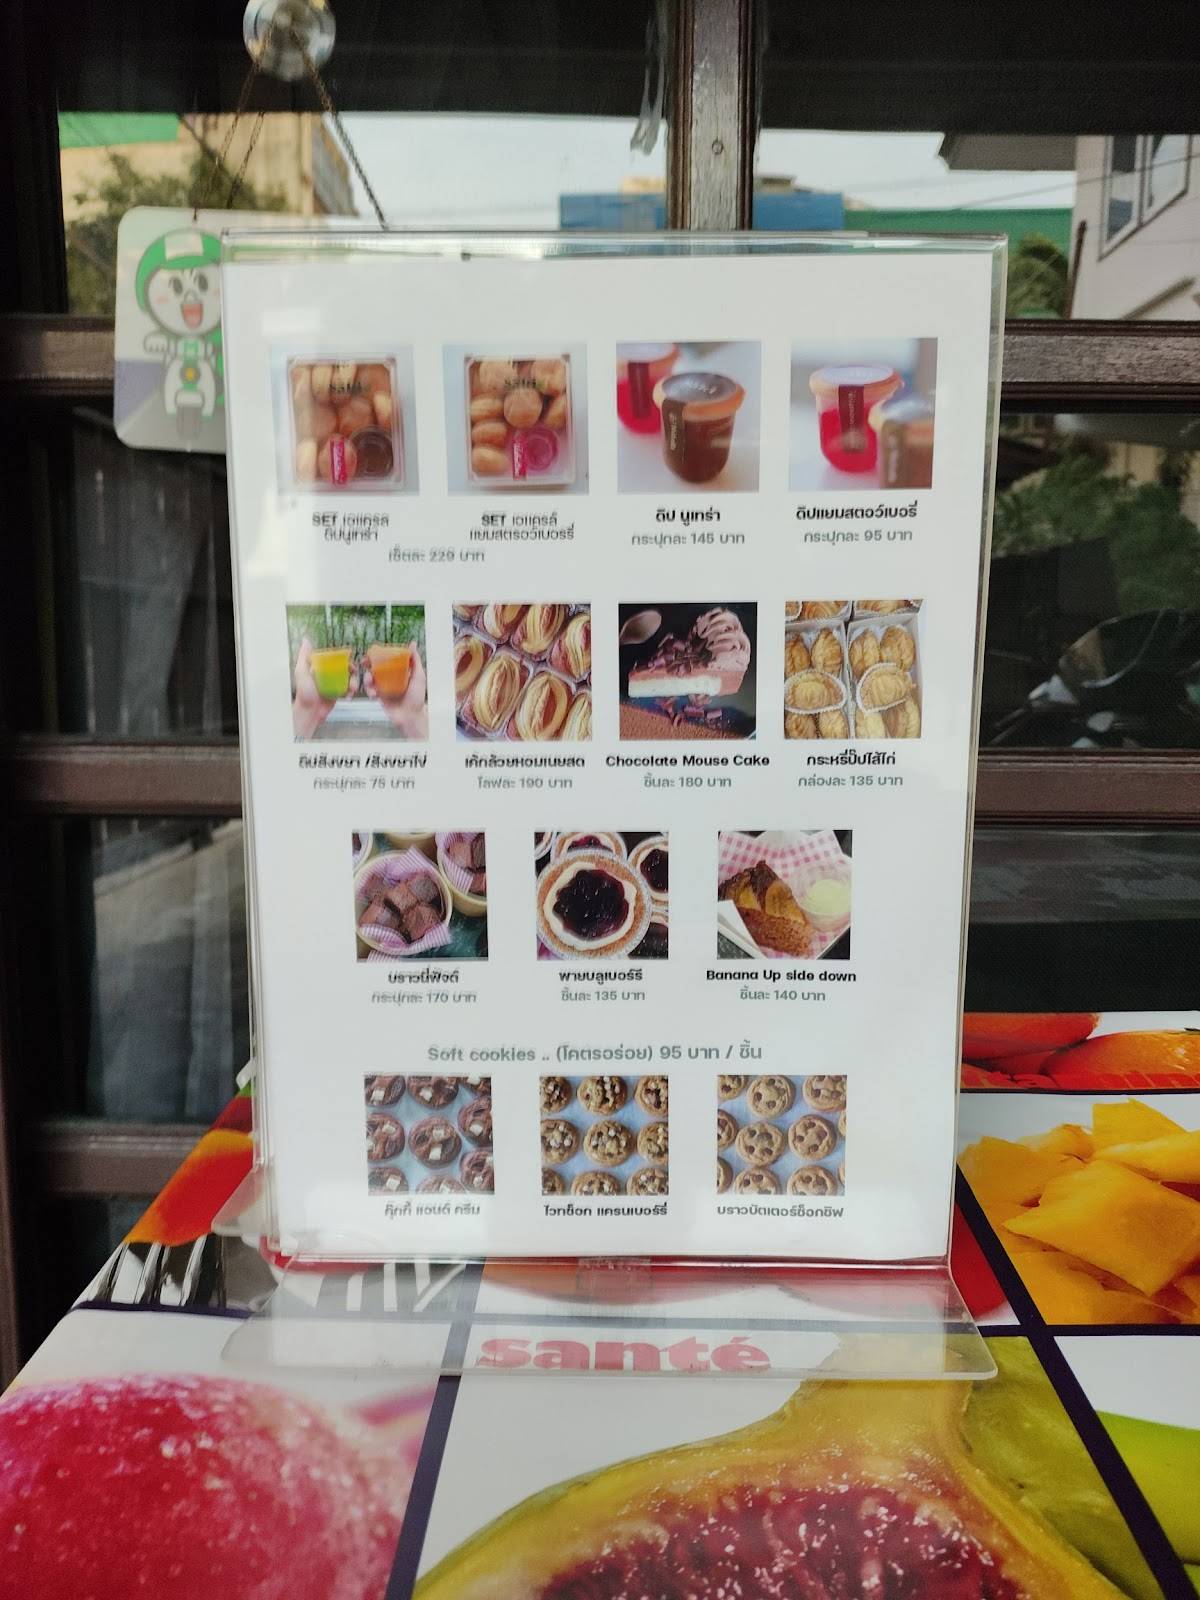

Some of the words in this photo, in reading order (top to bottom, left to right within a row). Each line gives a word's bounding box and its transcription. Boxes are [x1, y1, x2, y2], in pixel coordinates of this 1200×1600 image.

[312, 512, 338, 527] SET
[481, 511, 507, 526] SET
[690, 532, 715, 545] 145
[719, 530, 745, 545] บาท
[803, 530, 860, 546] กระปุกละ
[864, 530, 882, 541] 95
[886, 529, 913, 542] บาท
[459, 549, 485, 562] บาท
[605, 755, 678, 767] Chocolate
[682, 755, 729, 767] Mouse
[733, 755, 770, 767] Cake
[391, 776, 415, 789] บาท
[520, 776, 543, 789] 190
[548, 776, 573, 789] บาท
[679, 776, 703, 788] 180
[707, 775, 732, 788] บาท
[798, 773, 846, 787] กล่องละ
[850, 774, 874, 786] 135
[878, 774, 904, 786] บาท
[706, 970, 759, 980] Banana
[763, 970, 782, 982] Up
[786, 970, 815, 981] side
[818, 970, 857, 982] down
[426, 990, 449, 1003] 170
[453, 990, 477, 1003] บาท
[595, 990, 618, 1001] 135
[621, 990, 646, 1001] บาท
[774, 990, 798, 1001] 140
[801, 990, 826, 1001] บาท
[428, 1047, 464, 1062] Soft
[469, 1047, 536, 1062] cookies
[659, 1045, 683, 1060] 95
[687, 1044, 720, 1060] บาท
[739, 1038, 763, 1060] ชิ้น
